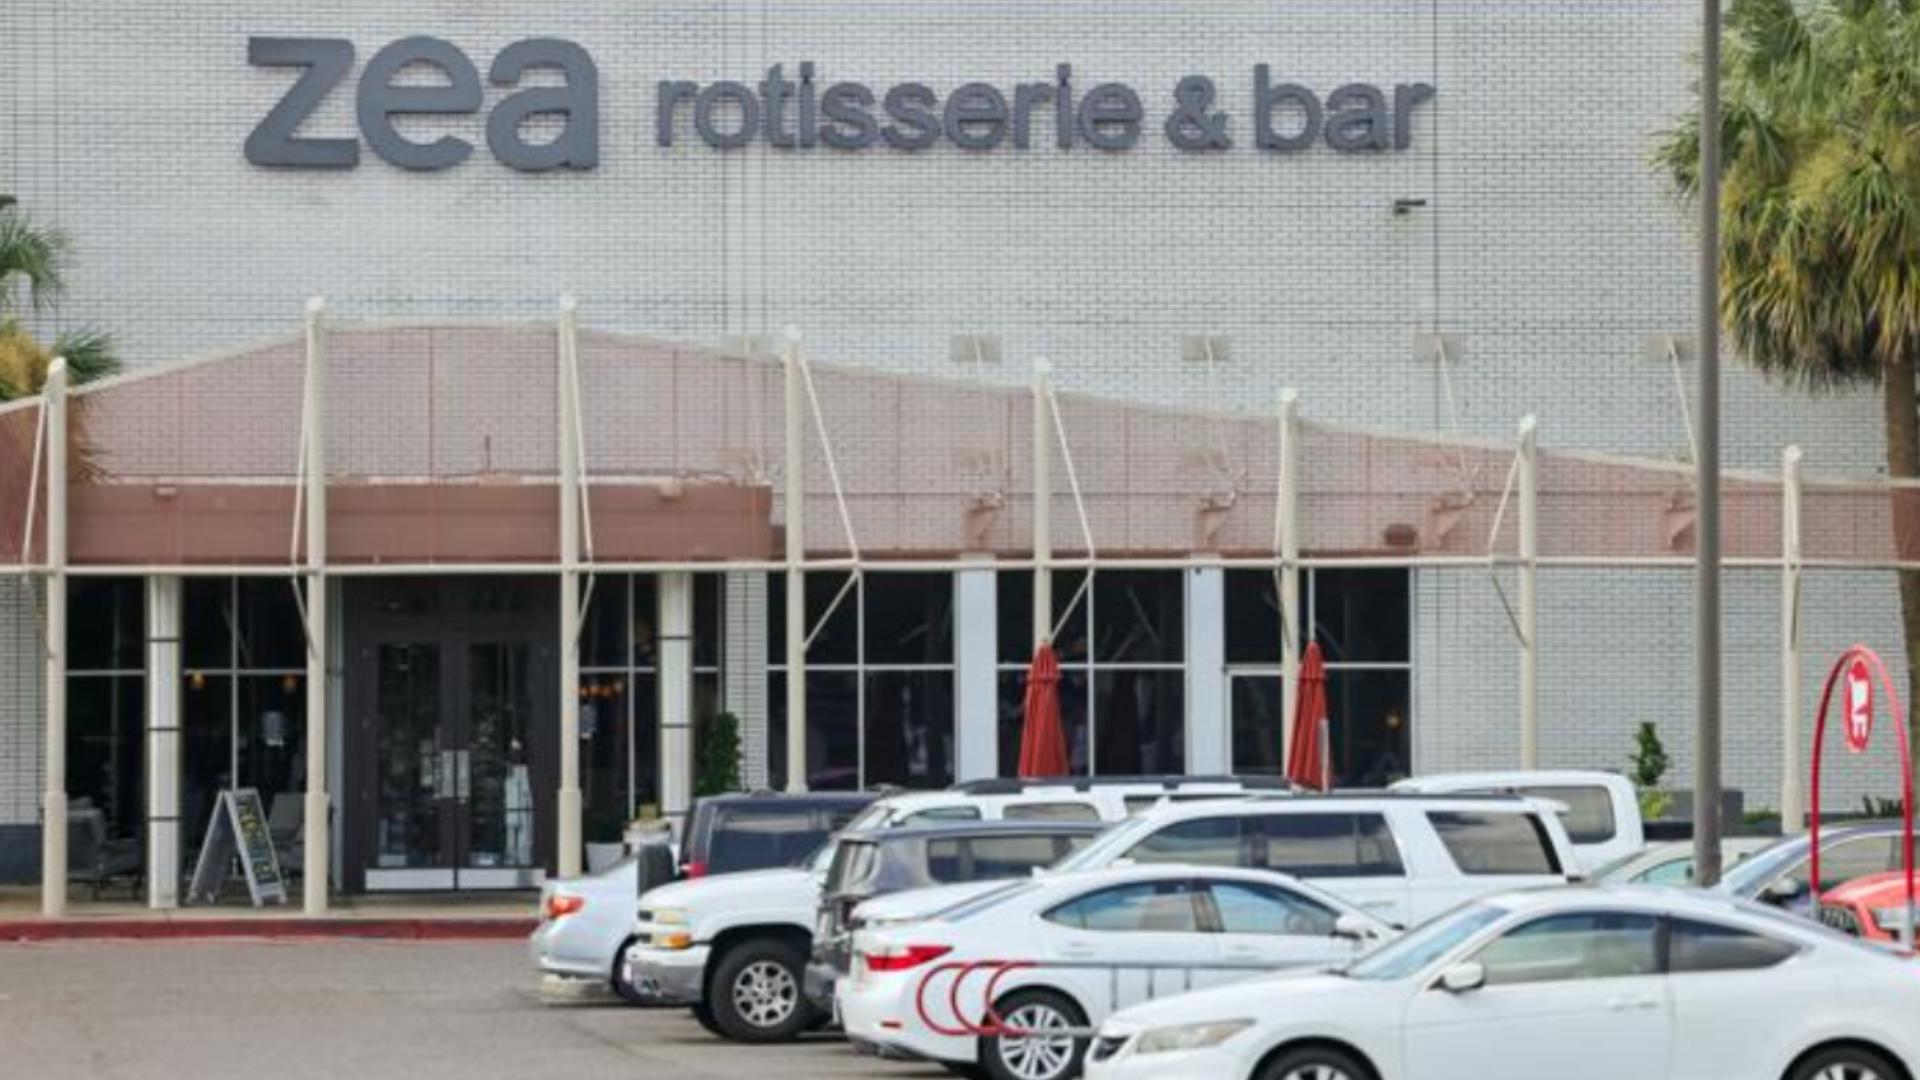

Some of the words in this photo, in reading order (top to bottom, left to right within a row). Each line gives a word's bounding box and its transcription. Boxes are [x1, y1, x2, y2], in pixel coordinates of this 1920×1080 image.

[244, 36, 599, 173] zea
[656, 62, 1144, 152] rotisserie
[1164, 75, 1233, 152] &
[1253, 64, 1436, 153] bar
